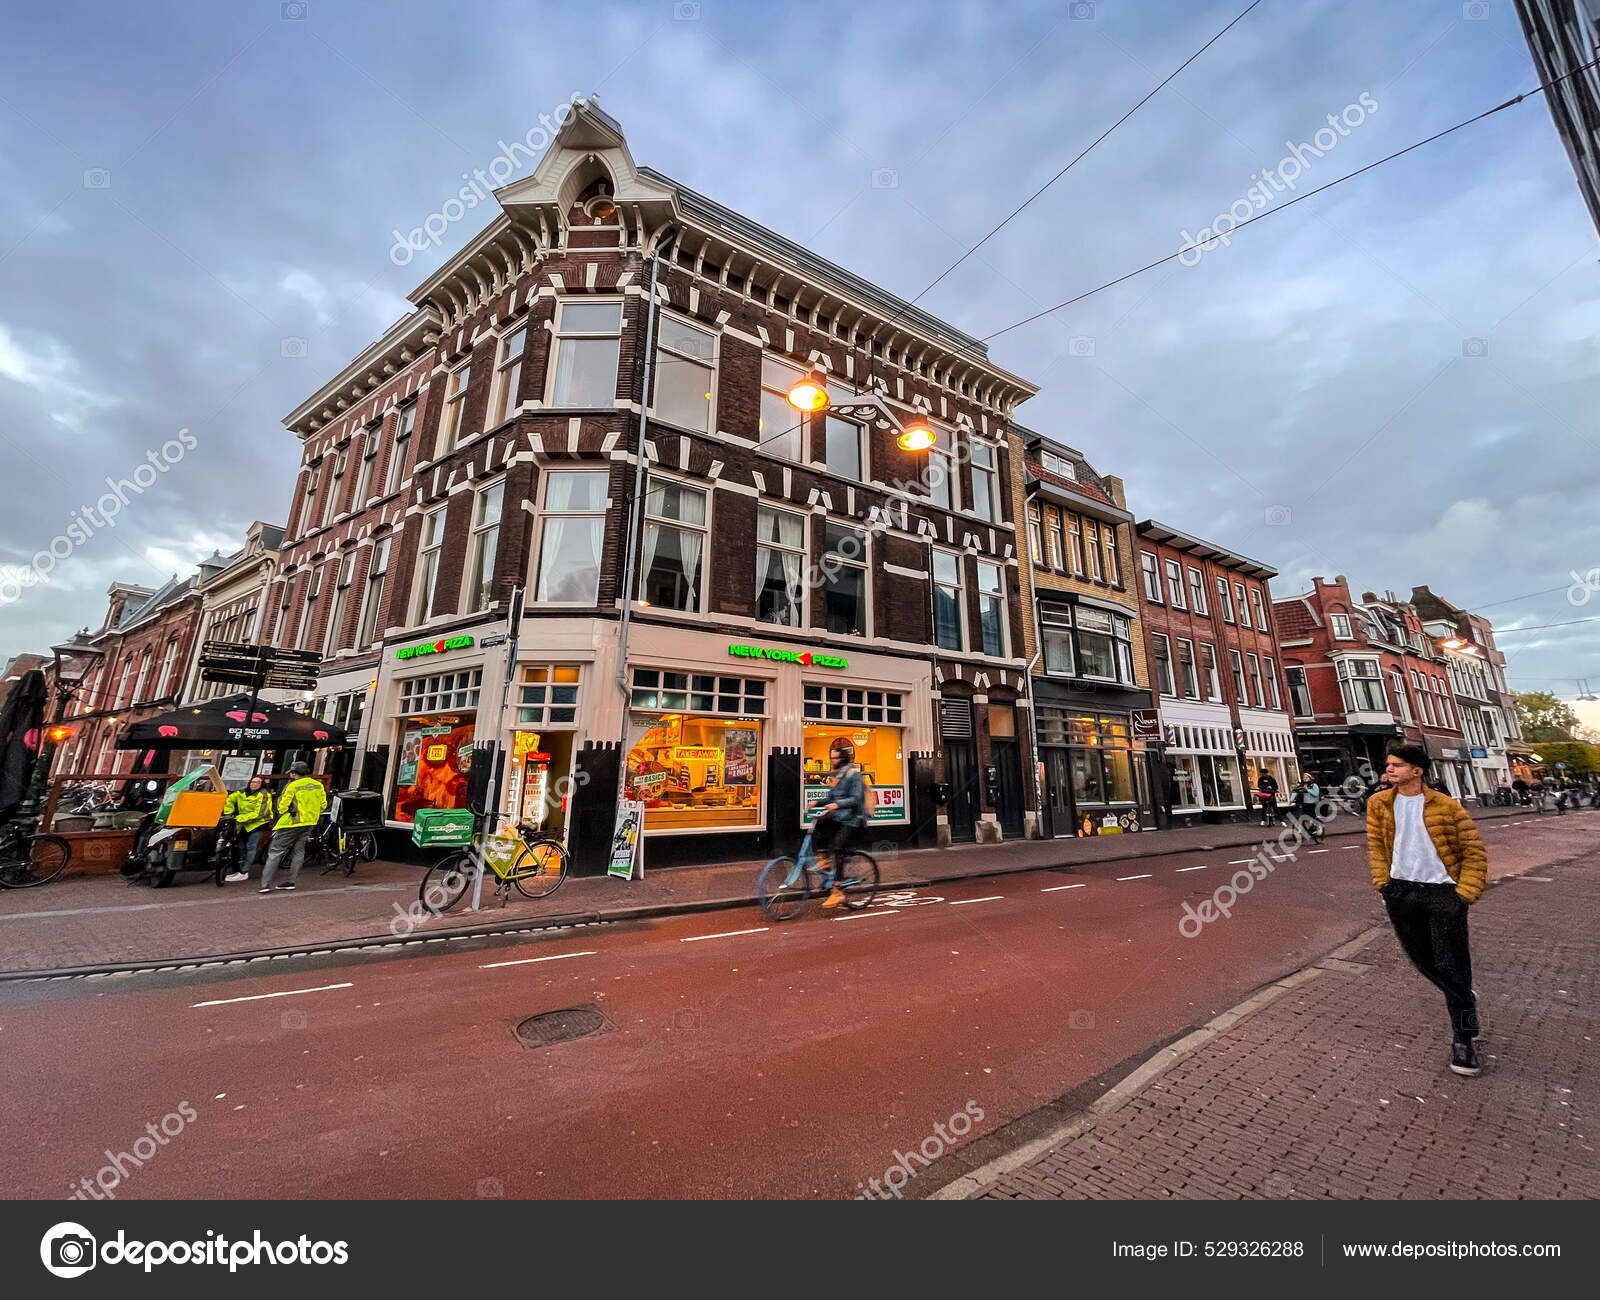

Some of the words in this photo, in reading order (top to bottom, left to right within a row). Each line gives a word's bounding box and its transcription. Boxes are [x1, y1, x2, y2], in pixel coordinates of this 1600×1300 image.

[397, 647, 415, 659] NEW
[415, 642, 439, 656] YORK
[444, 635, 472, 649] PIZZA
[729, 644, 763, 659] NEW
[764, 649, 804, 665] YORK
[811, 654, 849, 669] PIZZA
[676, 750, 696, 759] TAKE
[697, 750, 719, 759] AWAY
